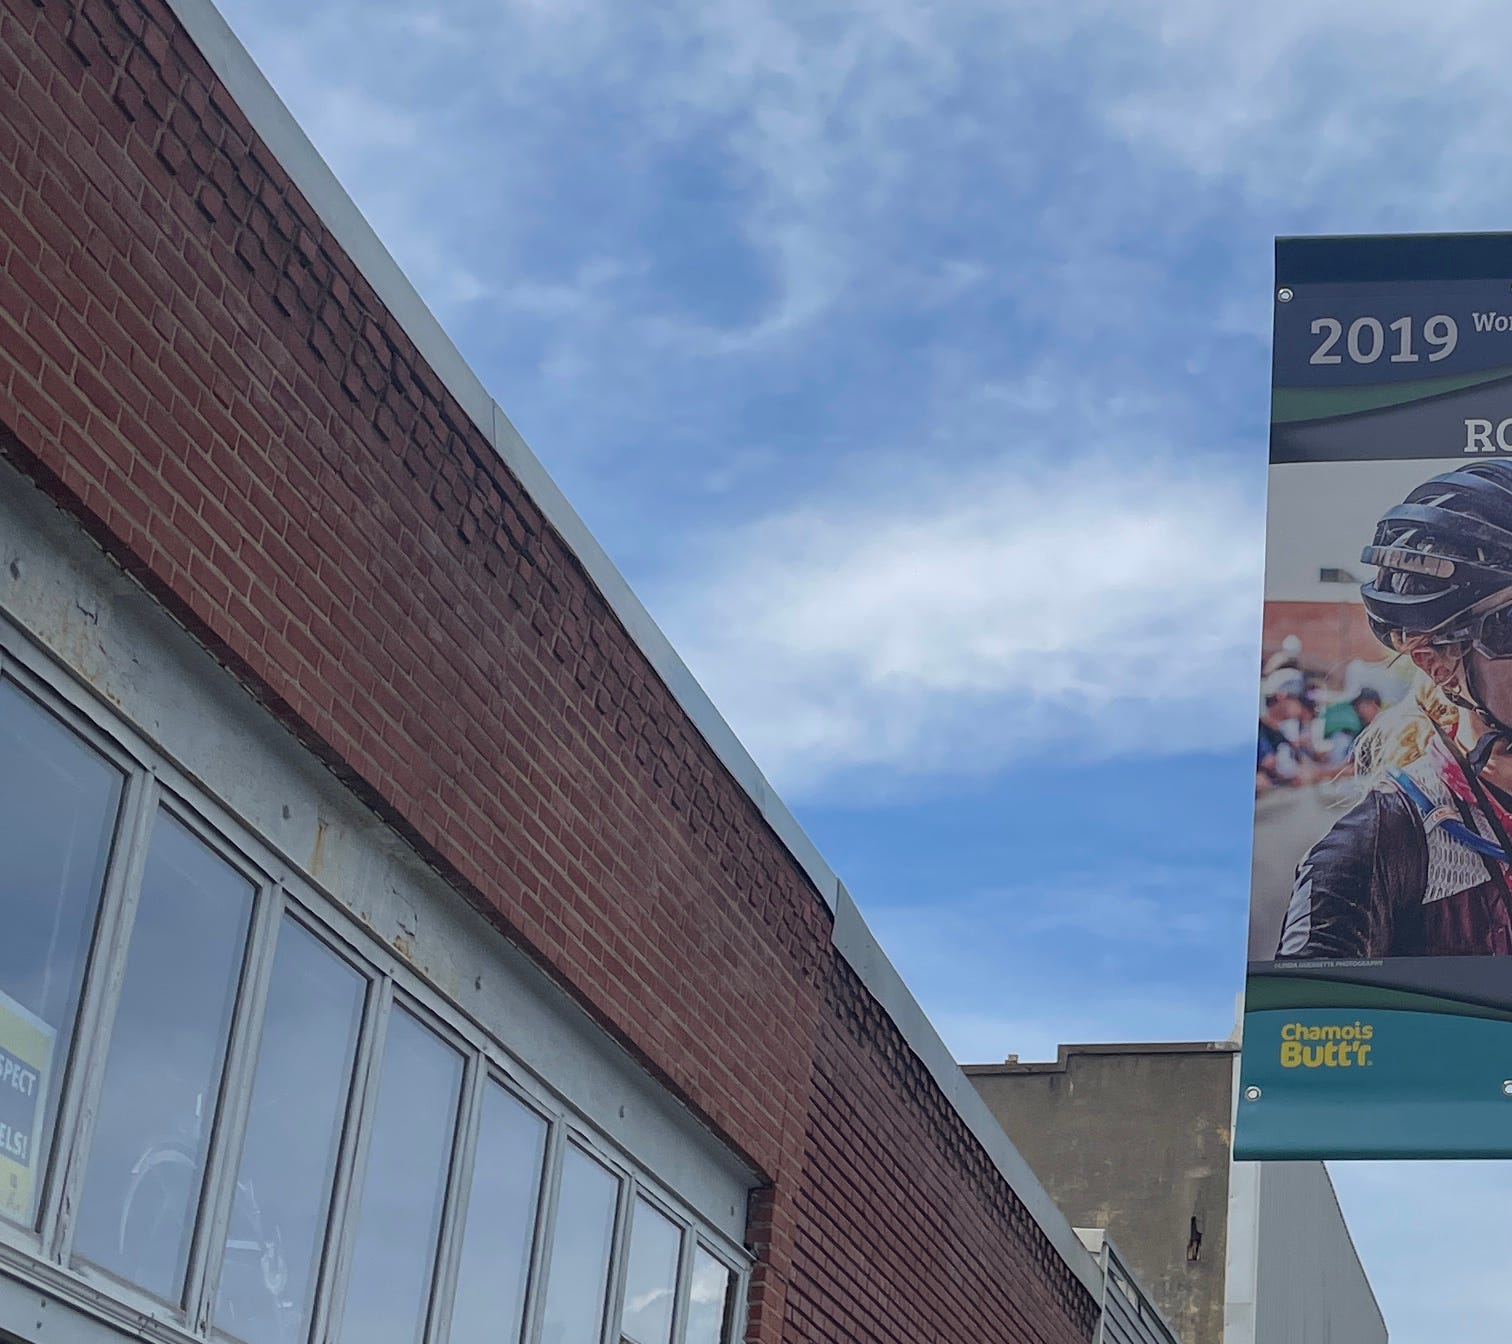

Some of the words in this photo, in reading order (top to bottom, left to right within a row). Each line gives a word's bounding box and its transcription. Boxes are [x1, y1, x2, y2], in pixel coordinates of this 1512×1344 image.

[1309, 314, 1459, 365] 2019
[1281, 1021, 1374, 1041] Chamois
[1281, 1041, 1372, 1068] Butt'r
